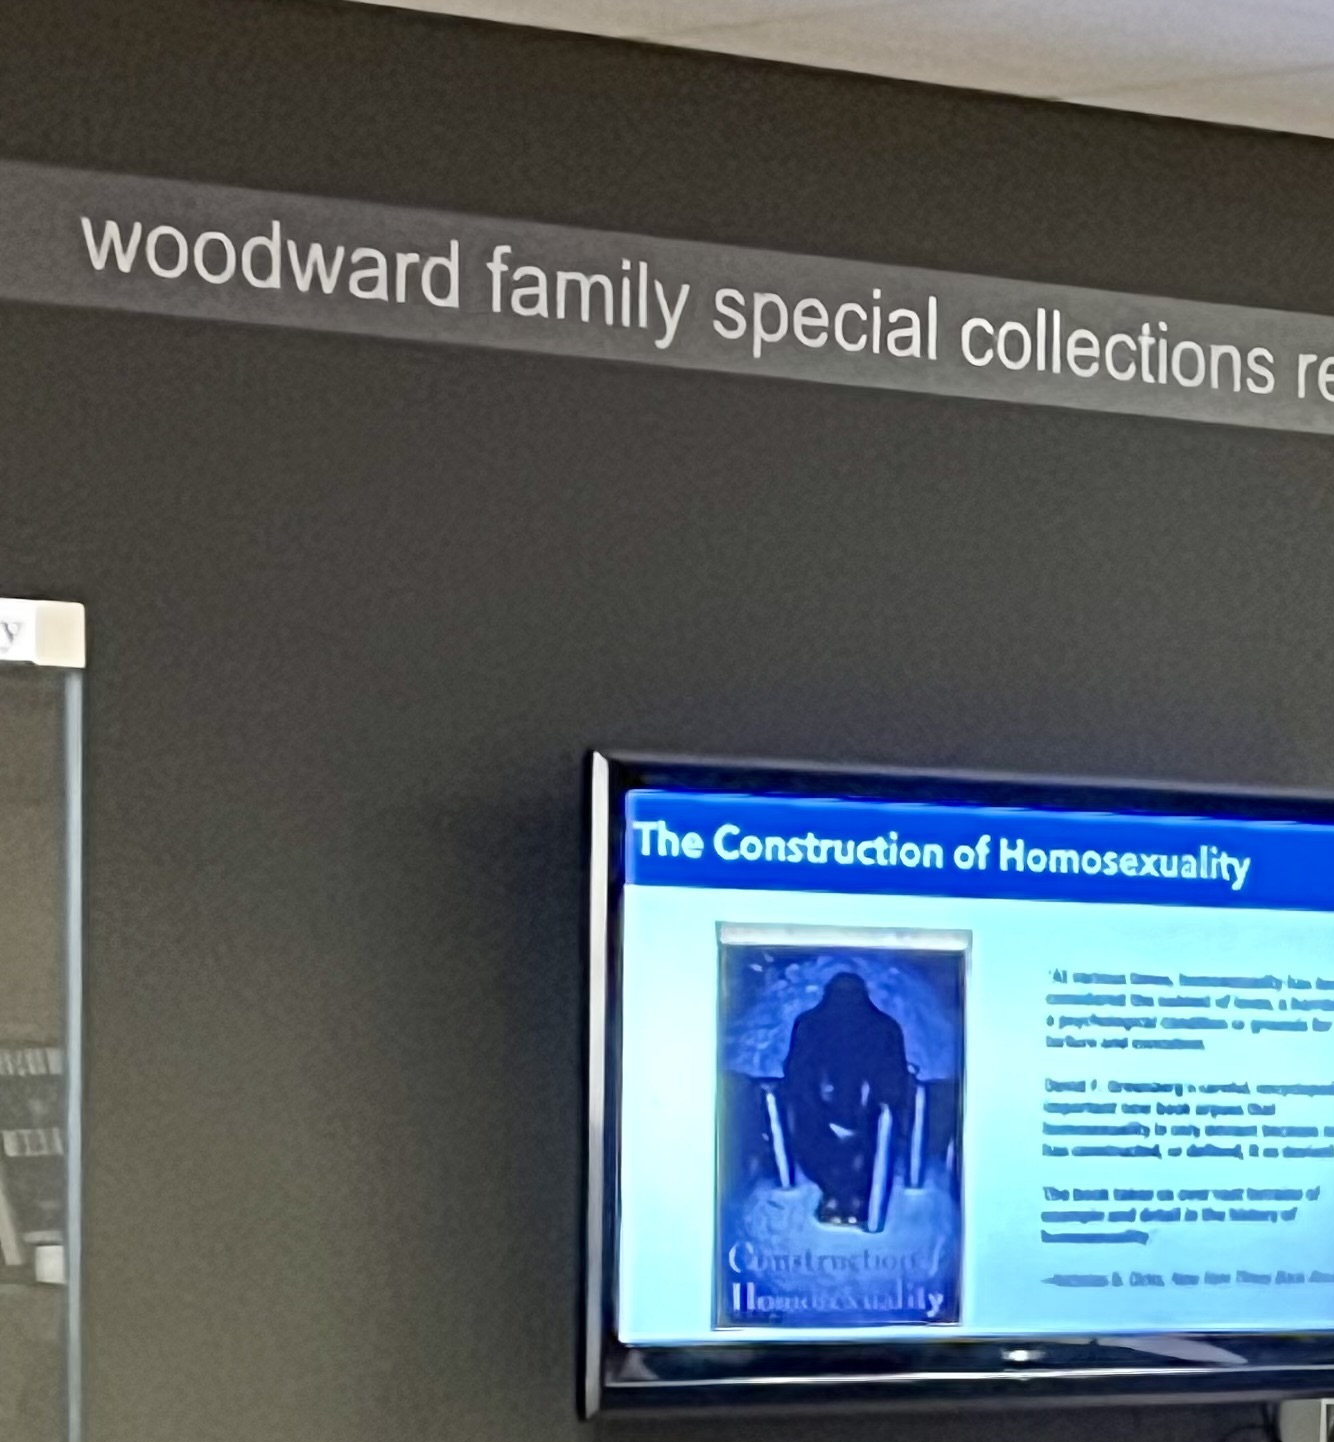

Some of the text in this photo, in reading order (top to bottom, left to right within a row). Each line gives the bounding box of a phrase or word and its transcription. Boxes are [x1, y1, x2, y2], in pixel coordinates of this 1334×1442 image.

[81, 217, 459, 308] woodward
[486, 245, 690, 349] family
[713, 288, 938, 359] special
[961, 307, 1275, 395] collections
[633, 820, 1251, 891] The Construction of Homosexuality
